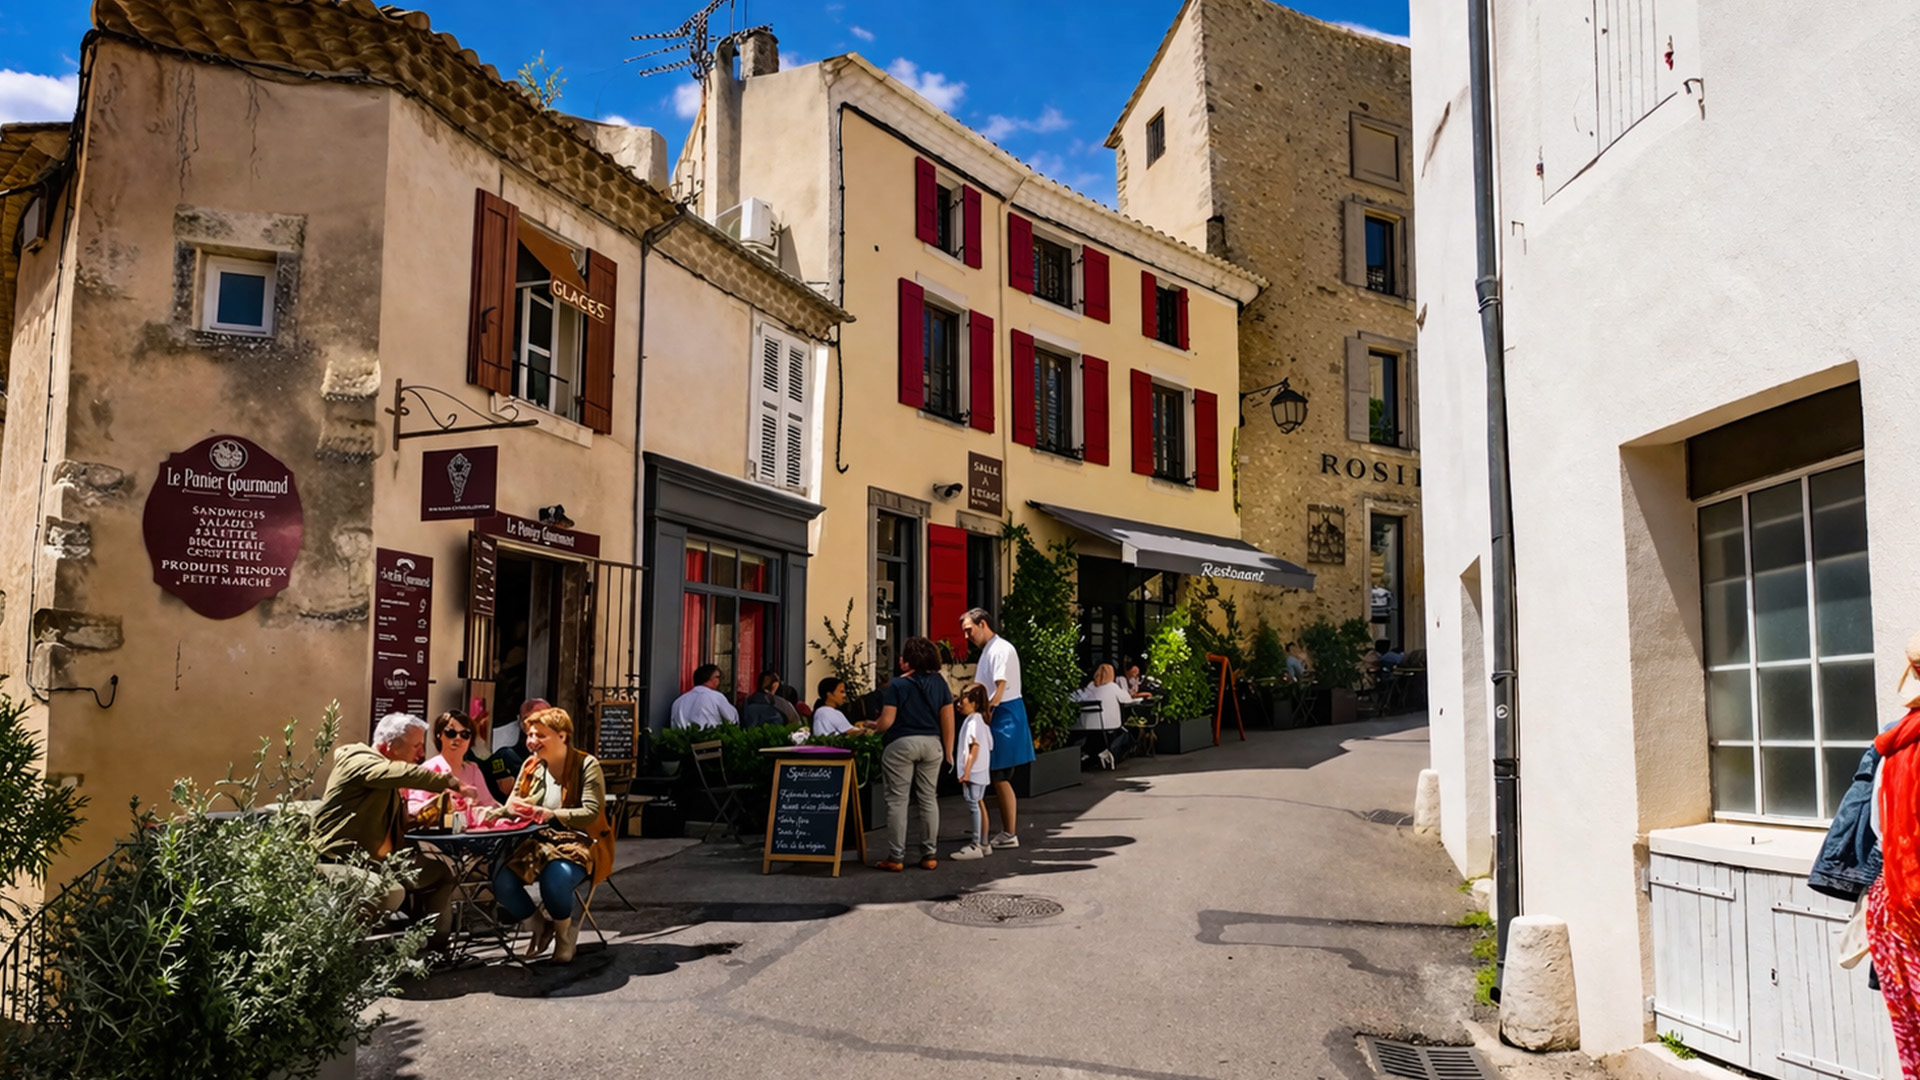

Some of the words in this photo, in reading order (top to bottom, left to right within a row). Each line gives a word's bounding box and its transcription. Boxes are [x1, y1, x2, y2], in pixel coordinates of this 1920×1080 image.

[552, 280, 611, 319] GLACES
[973, 462, 999, 476] SALLE
[167, 467, 181, 486] Le
[184, 468, 224, 489] Panier
[227, 472, 288, 497] Gourmand
[182, 574, 217, 584] PETIT
